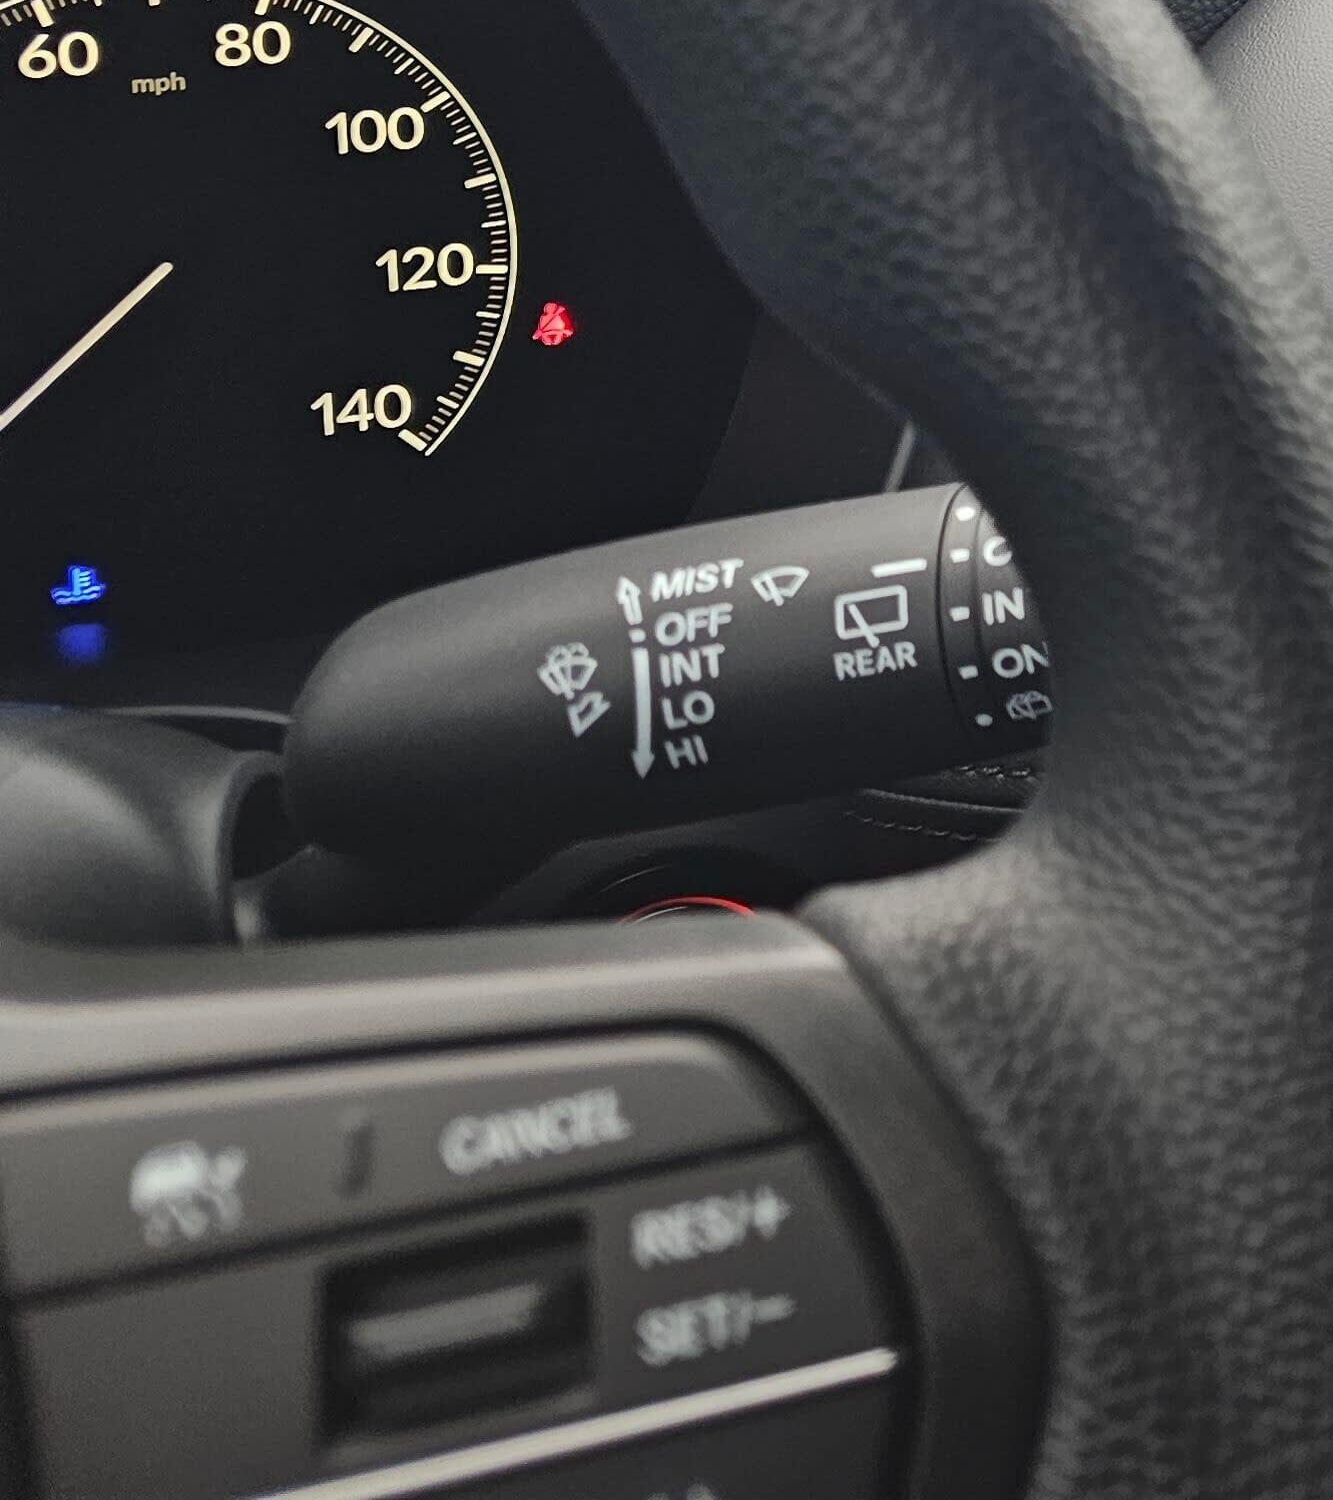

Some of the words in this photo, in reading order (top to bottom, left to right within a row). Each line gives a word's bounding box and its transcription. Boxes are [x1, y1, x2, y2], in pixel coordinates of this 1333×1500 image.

[17, 31, 99, 79] 60
[214, 20, 291, 67] 80
[131, 71, 187, 96] mph
[326, 107, 424, 154] 100
[375, 242, 474, 293] 120
[311, 384, 412, 436] 140
[650, 558, 744, 603] MIST
[654, 603, 733, 646] OFF
[659, 644, 725, 688] INT
[833, 641, 917, 680] REAR
[661, 689, 715, 730] LO
[664, 735, 709, 769] HI
[440, 1088, 630, 1174] CANCEL
